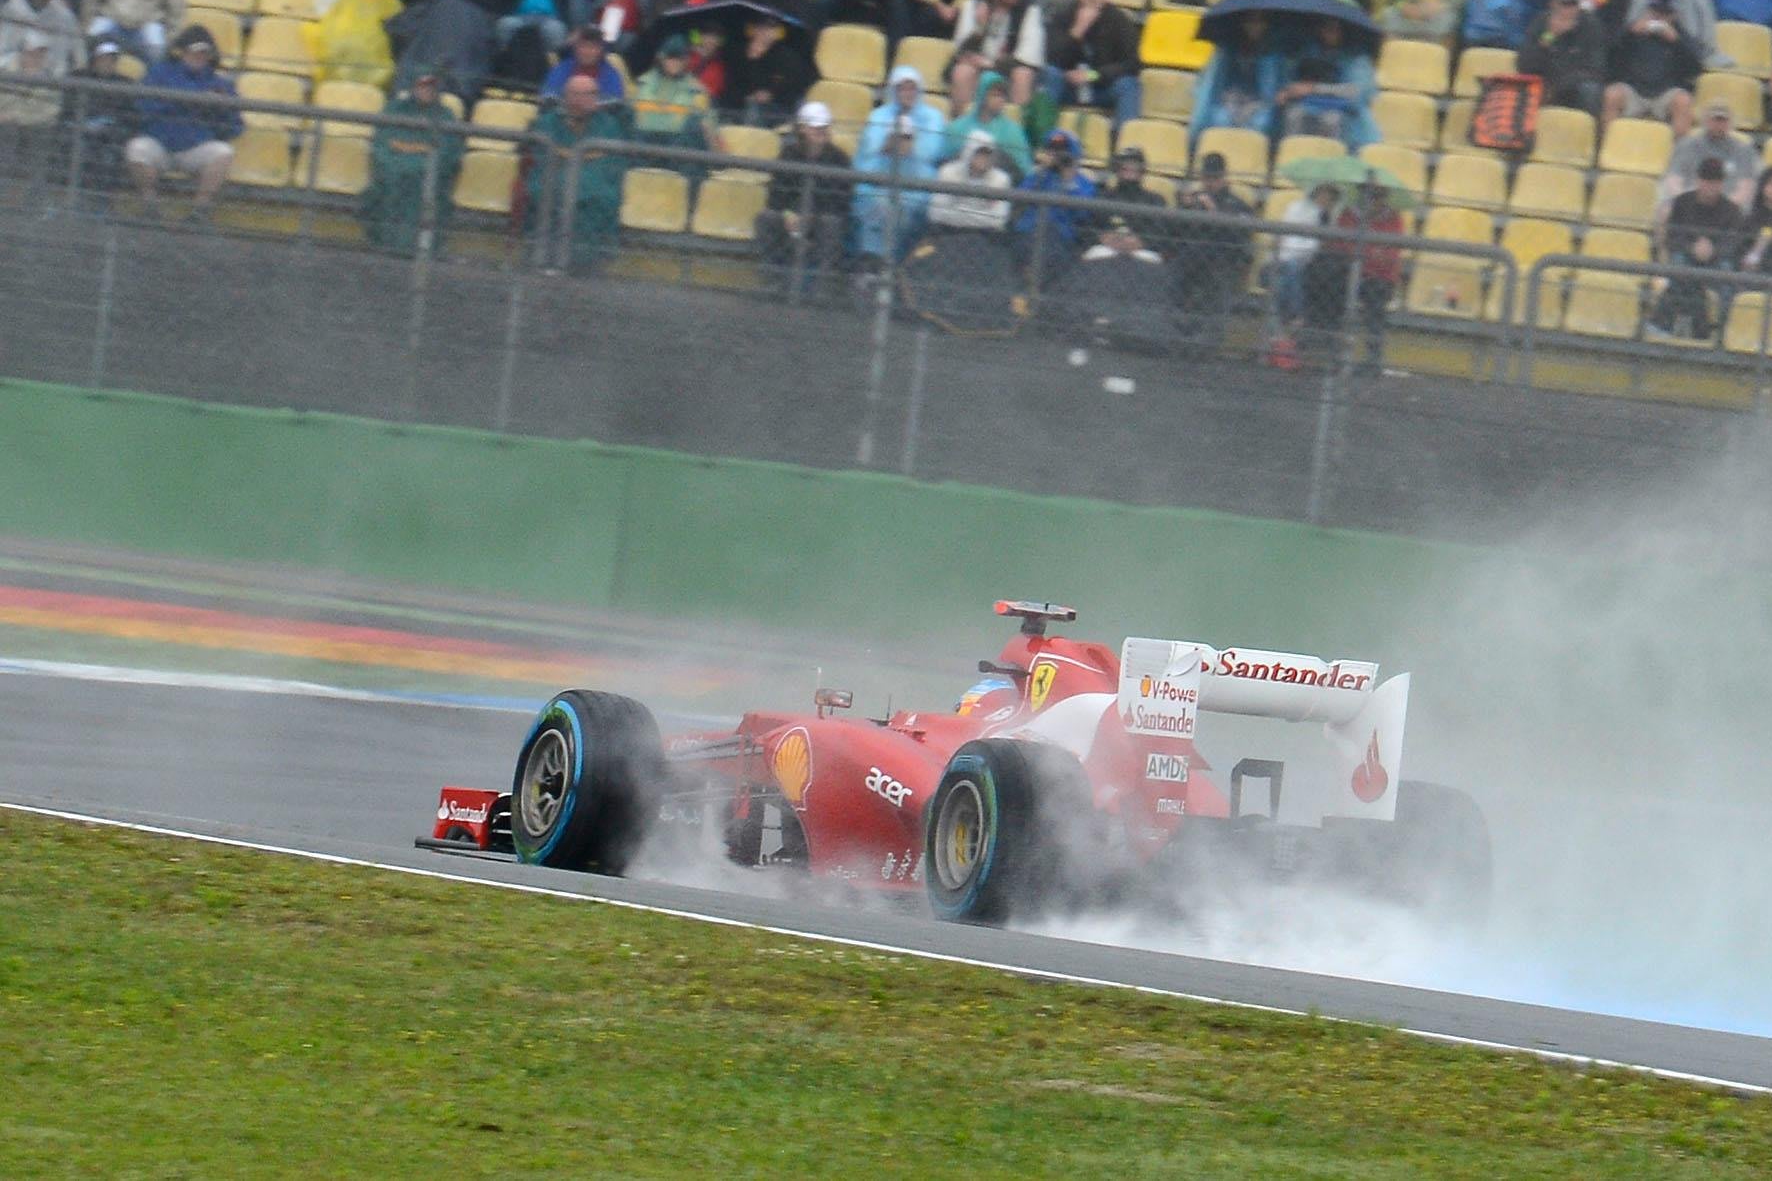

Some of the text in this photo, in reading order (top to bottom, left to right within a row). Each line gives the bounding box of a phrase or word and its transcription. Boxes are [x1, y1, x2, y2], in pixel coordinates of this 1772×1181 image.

[1216, 651, 1370, 692] Santander
[1152, 680, 1197, 703] V-Powe
[1147, 755, 1181, 779] AMD
[865, 765, 913, 808] acer
